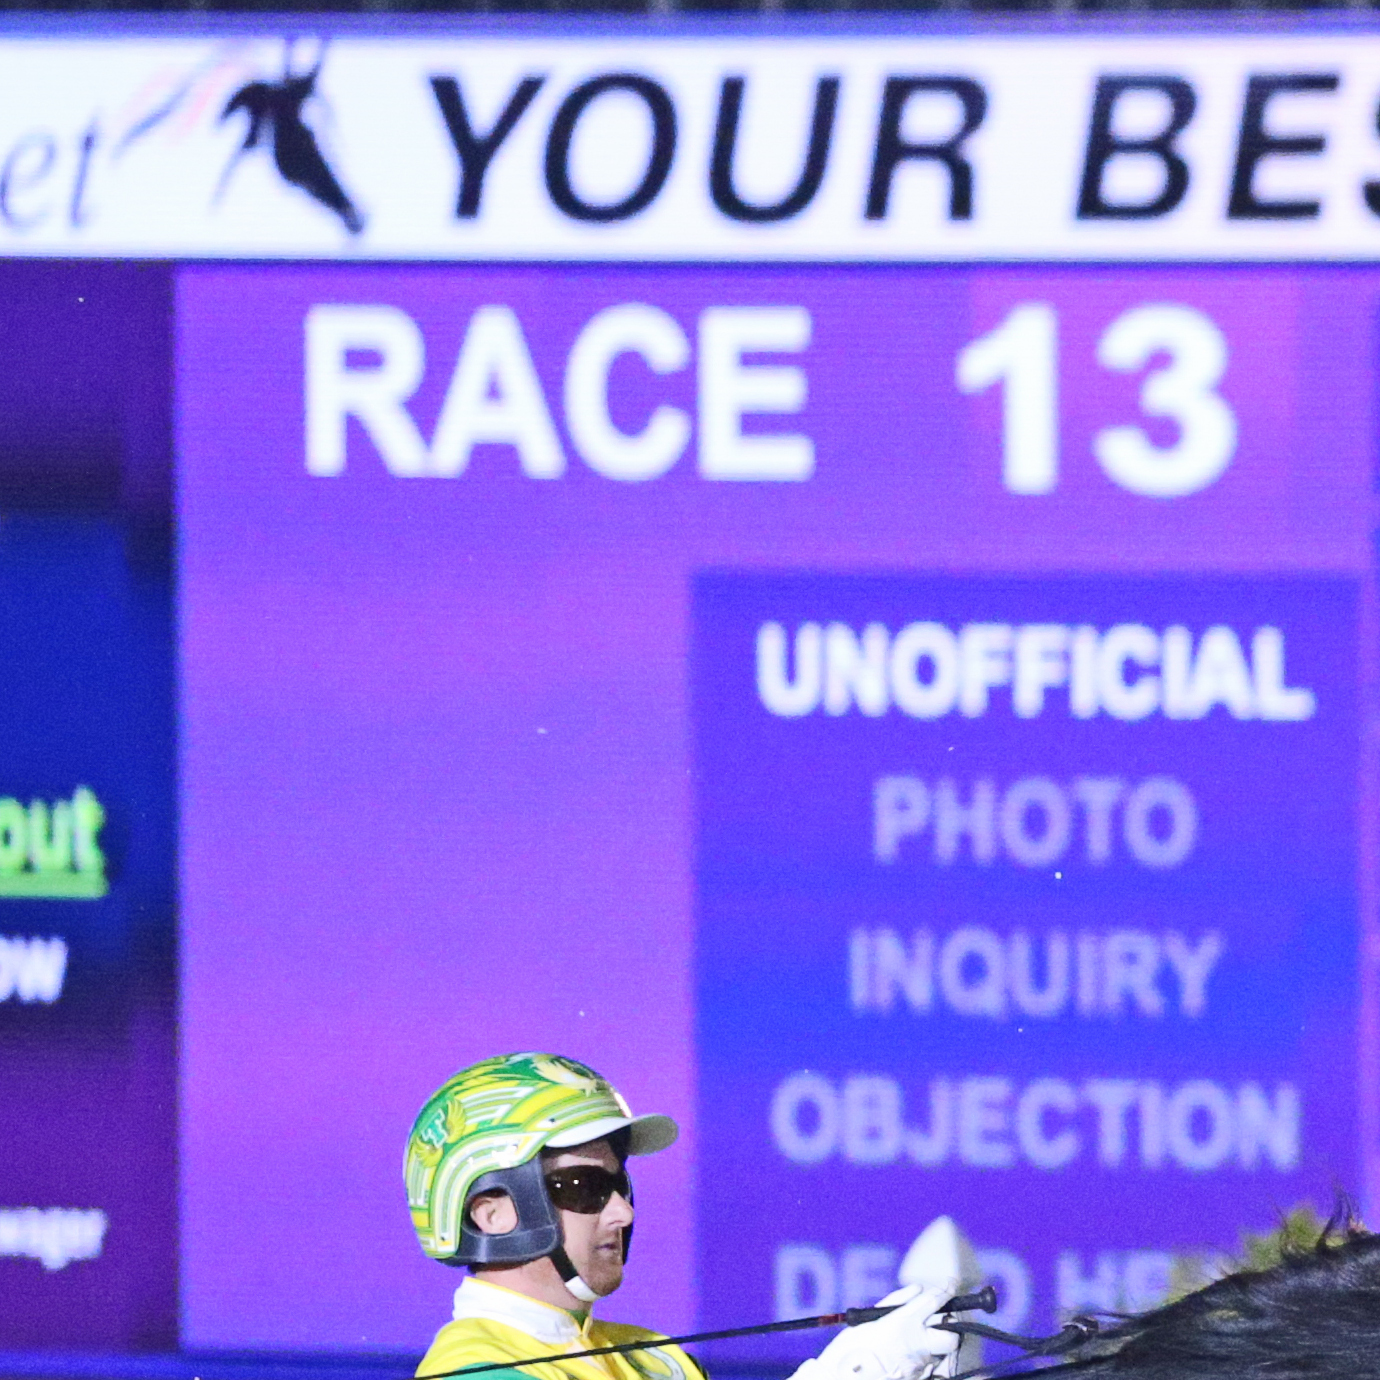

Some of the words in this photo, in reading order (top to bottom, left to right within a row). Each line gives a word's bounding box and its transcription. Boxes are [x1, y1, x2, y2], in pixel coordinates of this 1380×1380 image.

[429, 70, 989, 226] YOUR
[304, 303, 815, 482] RACE
[957, 302, 1237, 497] 13
[756, 621, 1316, 721] UNOFFICIAL
[872, 774, 1199, 867] PHOTO
[848, 926, 1222, 1018] INQUIRY
[769, 1069, 1302, 1172] OBJECTION
[775, 1244, 1032, 1335] DED
